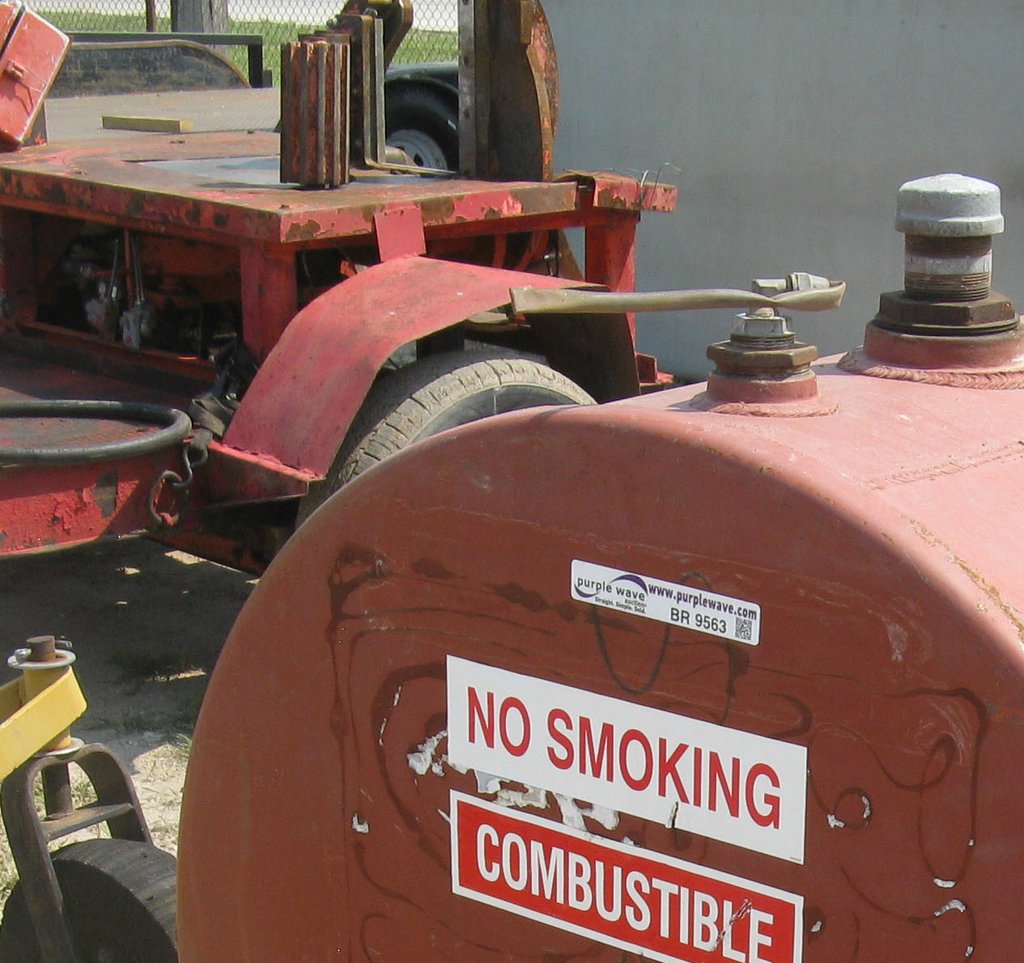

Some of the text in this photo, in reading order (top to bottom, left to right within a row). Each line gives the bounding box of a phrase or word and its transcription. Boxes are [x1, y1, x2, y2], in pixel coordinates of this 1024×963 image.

[577, 577, 646, 602] purple wave
[648, 583, 757, 620] www.purplewave.com
[670, 607, 727, 634] BR 9563
[467, 686, 781, 830] NO SMOKING
